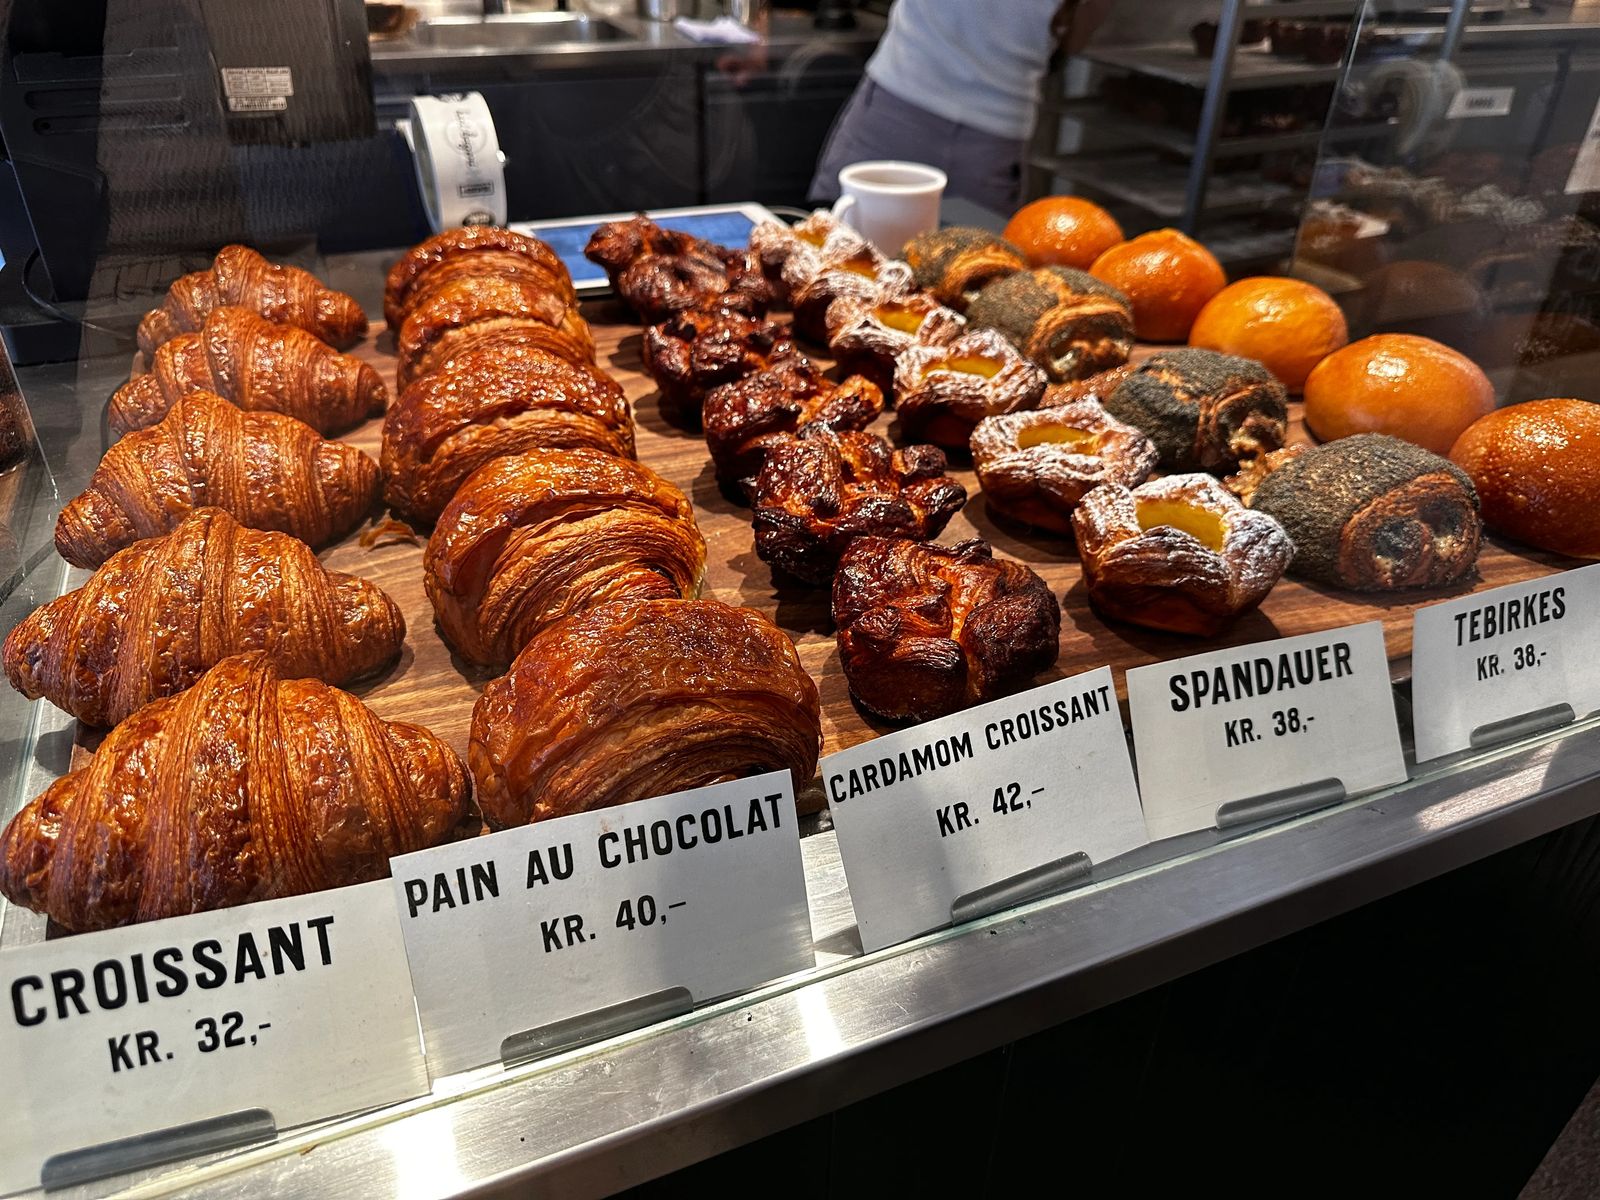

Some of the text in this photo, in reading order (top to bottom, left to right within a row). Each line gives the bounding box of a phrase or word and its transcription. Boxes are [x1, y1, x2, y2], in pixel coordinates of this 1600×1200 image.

[1454, 586, 1566, 647] TEBIRKES
[1168, 641, 1354, 713] SPANDAUER
[1476, 644, 1547, 682] KR. 38,-
[829, 685, 1110, 803] CARDAMOM CROISSANT
[1224, 707, 1315, 748] KR. 38,-
[935, 782, 1045, 838] KR. 42,-
[403, 793, 783, 918] PAIN AU CHOCOLAT
[540, 894, 687, 953] KR. 40,-
[10, 915, 334, 1027] CROISSANT
[108, 1011, 272, 1073] KR. 32,-
